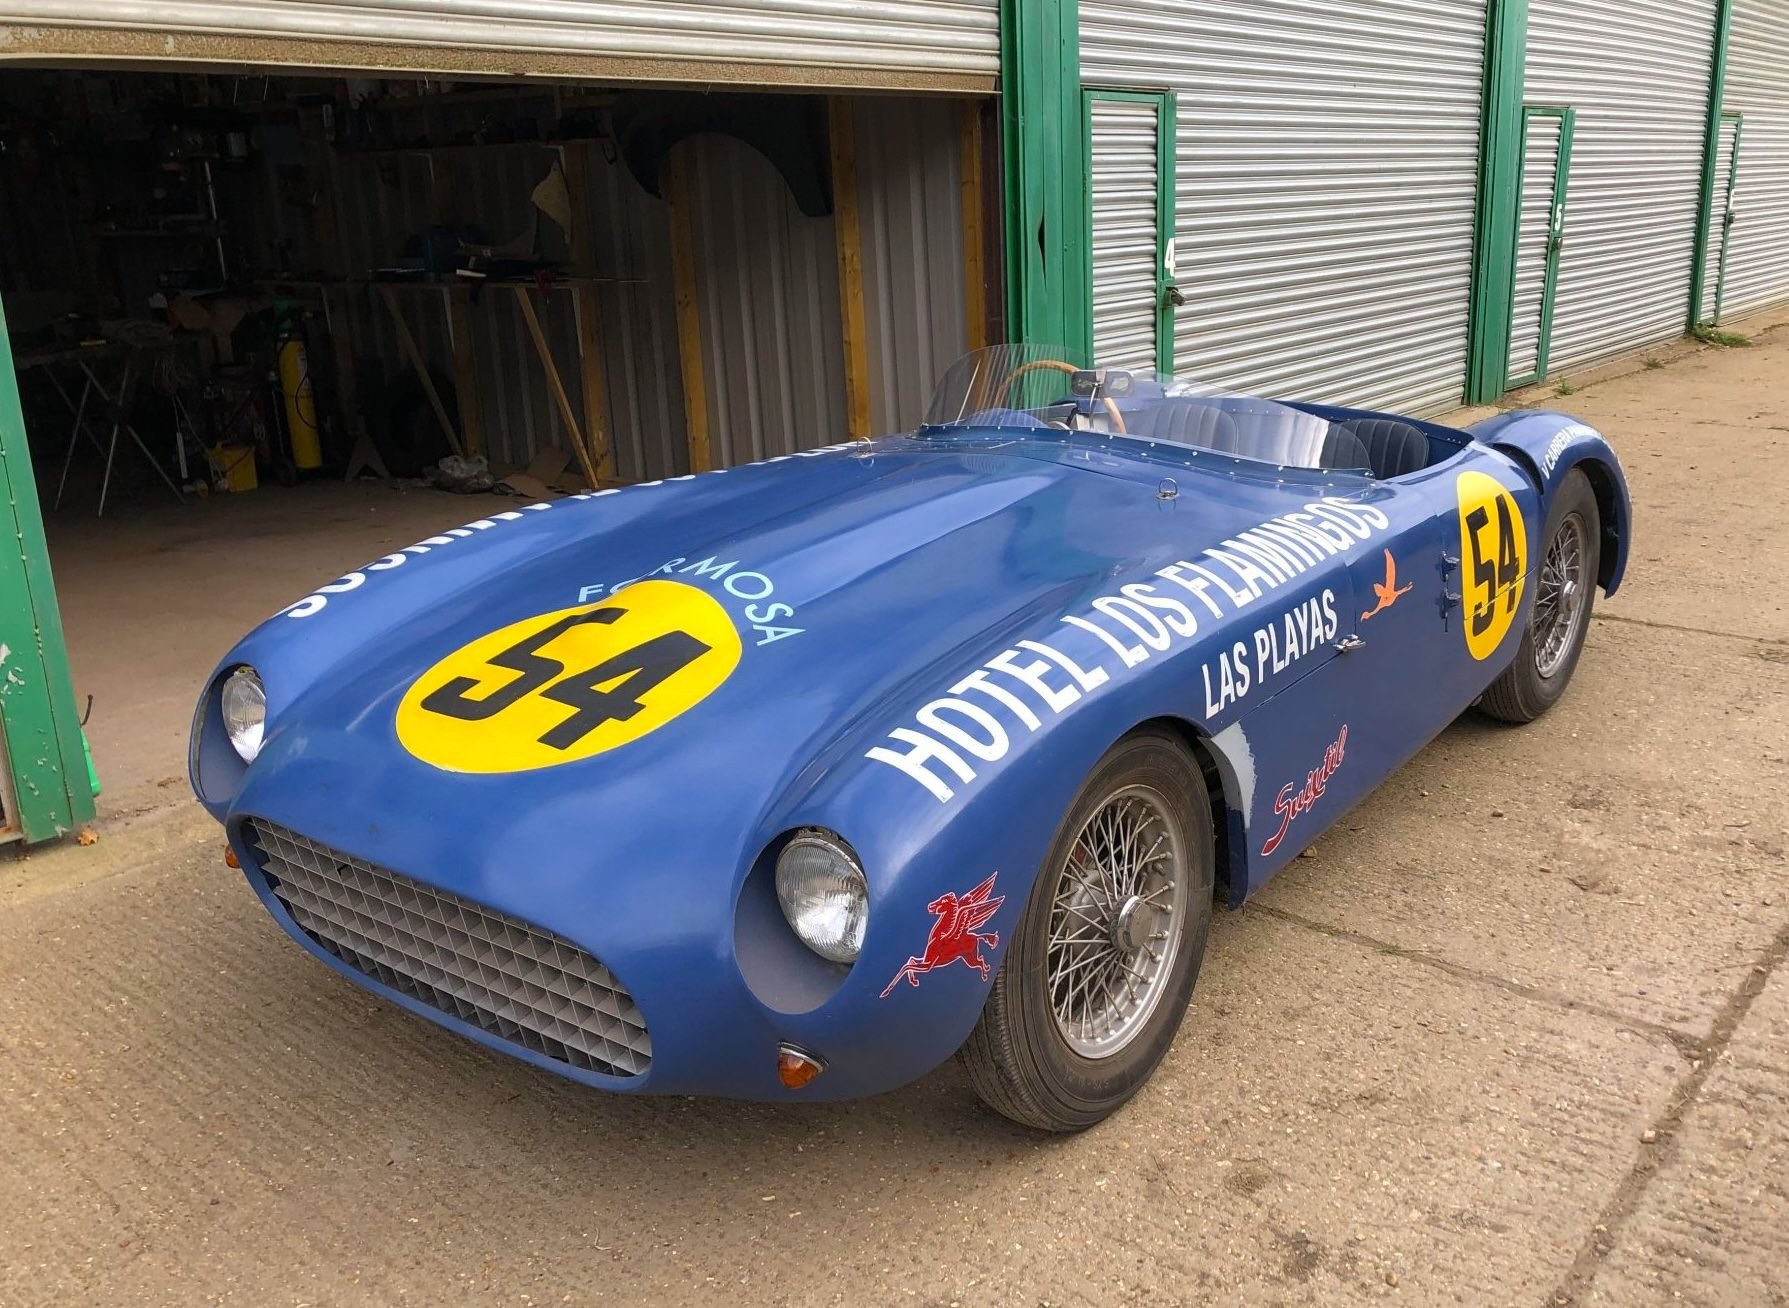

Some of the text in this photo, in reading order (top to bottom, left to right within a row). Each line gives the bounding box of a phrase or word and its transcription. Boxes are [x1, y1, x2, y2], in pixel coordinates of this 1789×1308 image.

[1164, 237, 1176, 277] 4
[1555, 203, 1563, 231] 5
[1465, 493, 1520, 637] 54
[420, 607, 712, 750] 54
[864, 496, 1391, 803] HOTEL LOS FLAMINGOS
[1201, 588, 1338, 720] LAS PLAYAS
